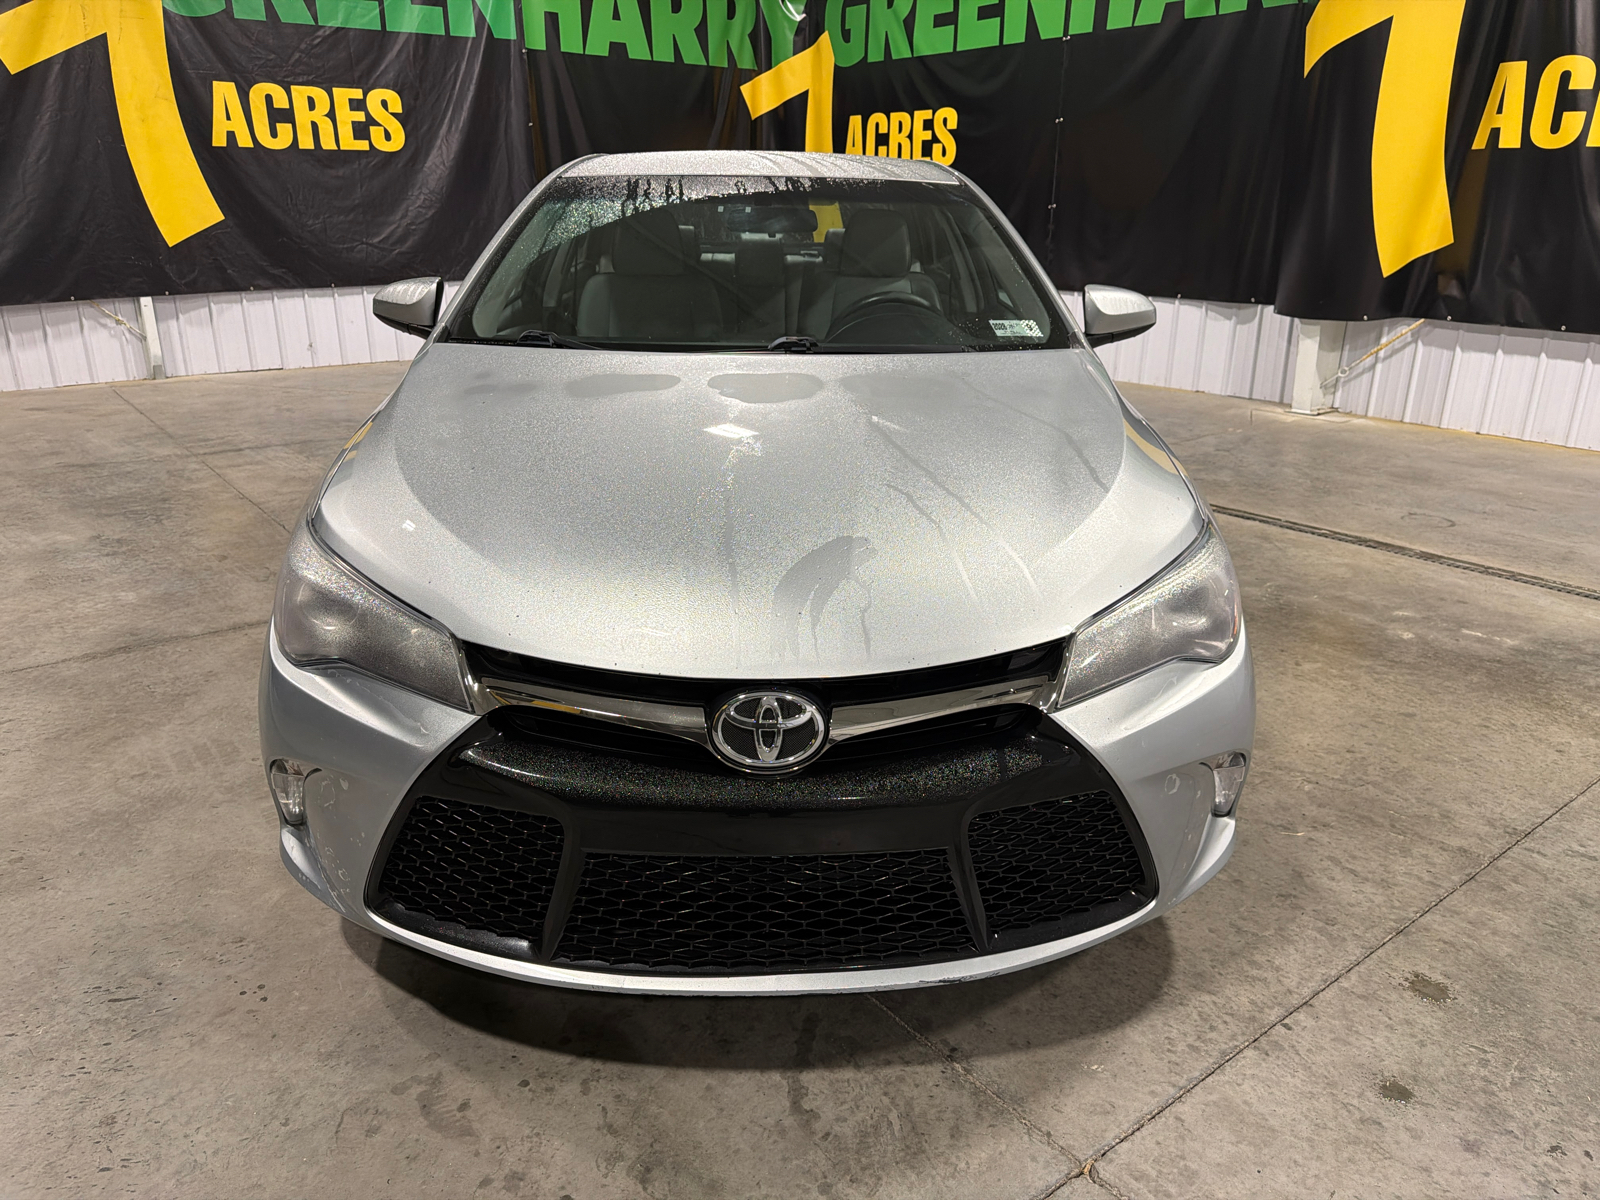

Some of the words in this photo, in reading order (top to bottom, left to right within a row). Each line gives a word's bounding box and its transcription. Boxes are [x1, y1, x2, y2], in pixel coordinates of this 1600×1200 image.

[211, 80, 406, 153] ACRES
[845, 107, 959, 167] ACRES
[1471, 54, 1600, 150] AC
